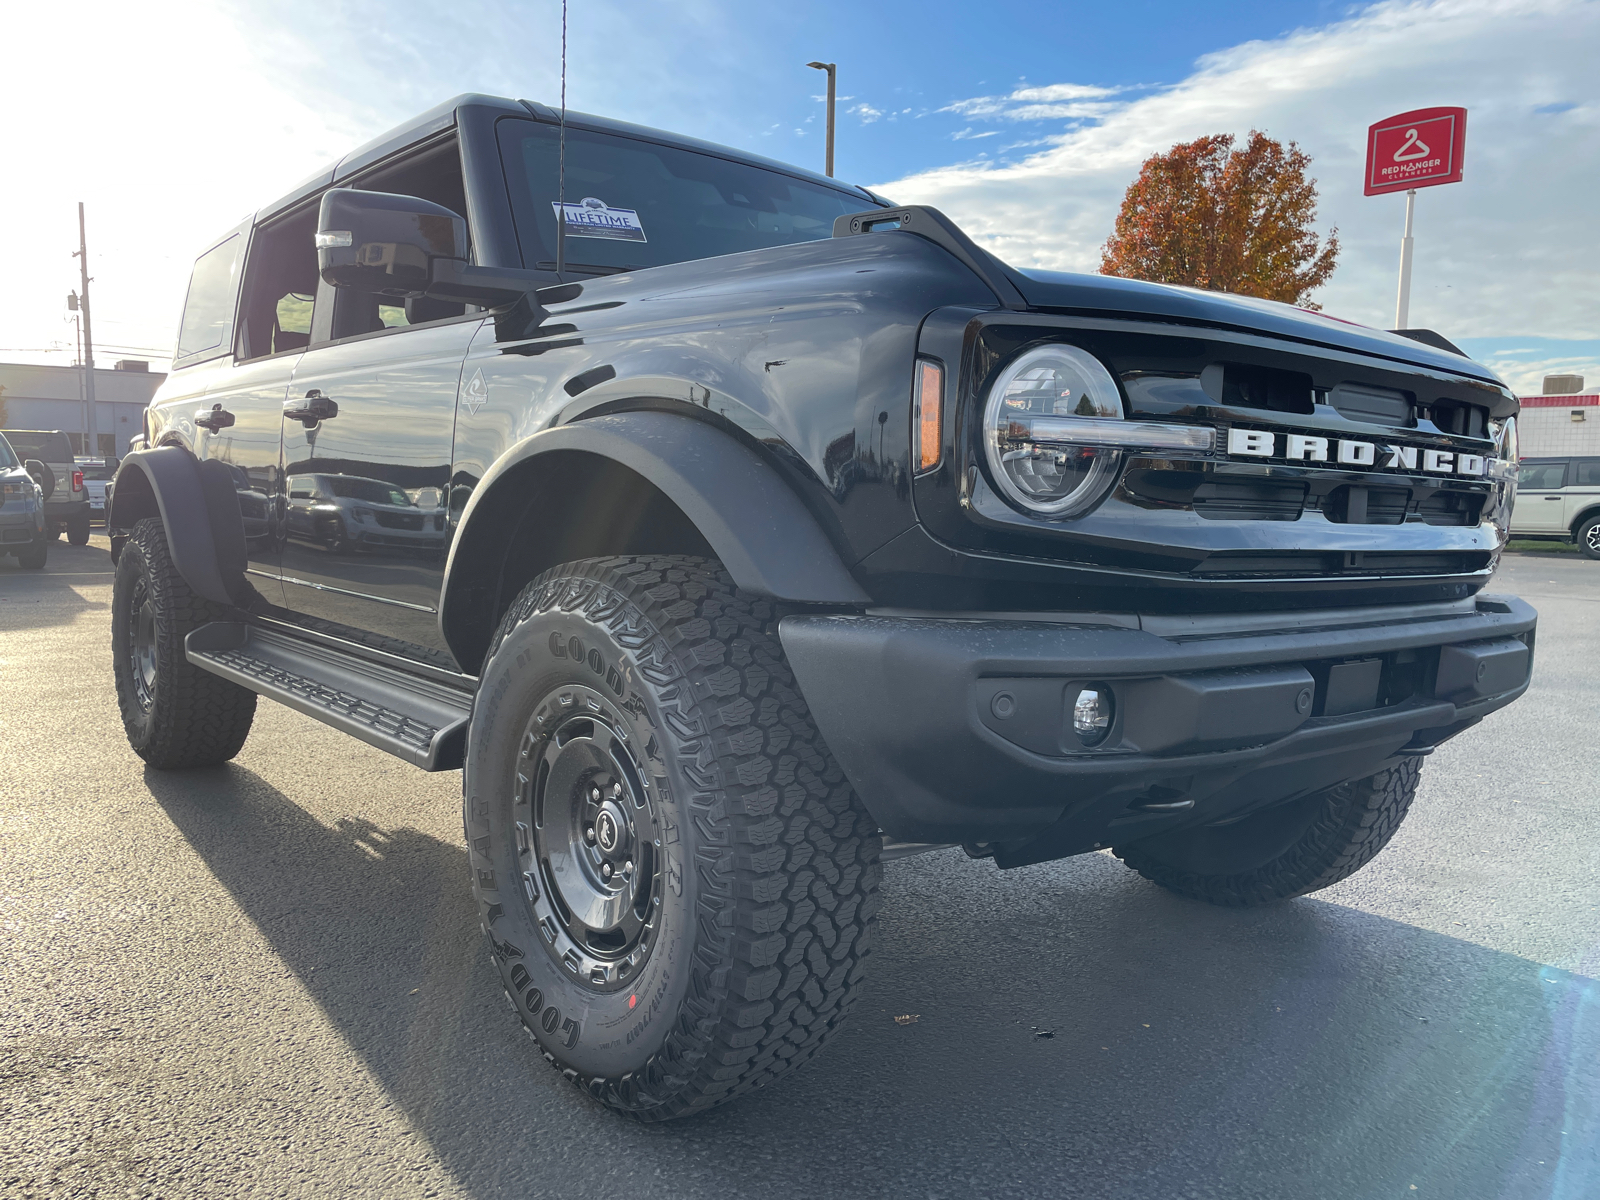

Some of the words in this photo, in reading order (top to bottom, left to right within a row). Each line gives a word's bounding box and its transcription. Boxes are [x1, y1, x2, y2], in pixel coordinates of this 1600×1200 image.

[1382, 166, 1399, 175] RED
[1400, 159, 1441, 172] HANGER
[1388, 168, 1432, 180] CLEANERS
[566, 212, 632, 227] LIFETIME
[1227, 428, 1484, 477] BRONCO
